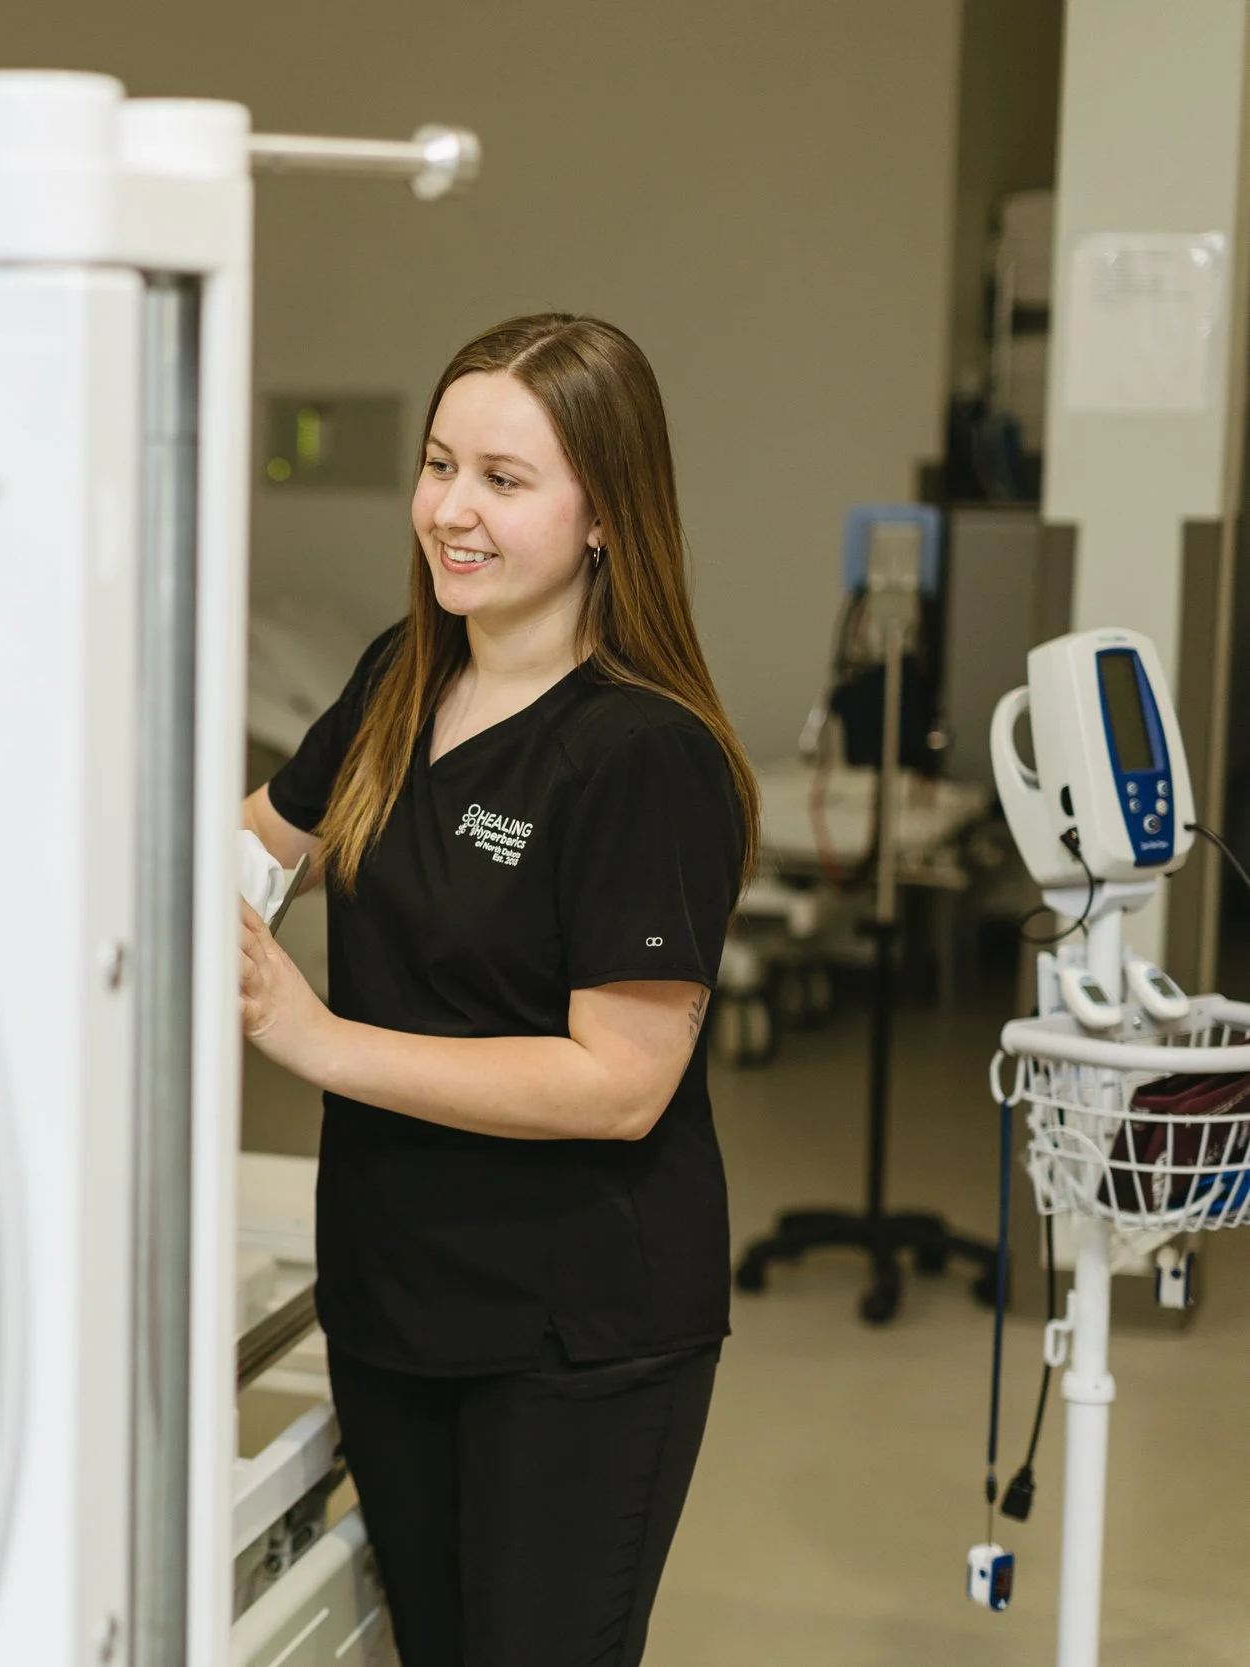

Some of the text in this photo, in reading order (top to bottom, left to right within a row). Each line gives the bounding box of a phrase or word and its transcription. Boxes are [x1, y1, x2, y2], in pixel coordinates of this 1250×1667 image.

[476, 810, 533, 838] HEALING
[474, 826, 527, 849] Hyperbarics
[482, 841, 502, 854] North
